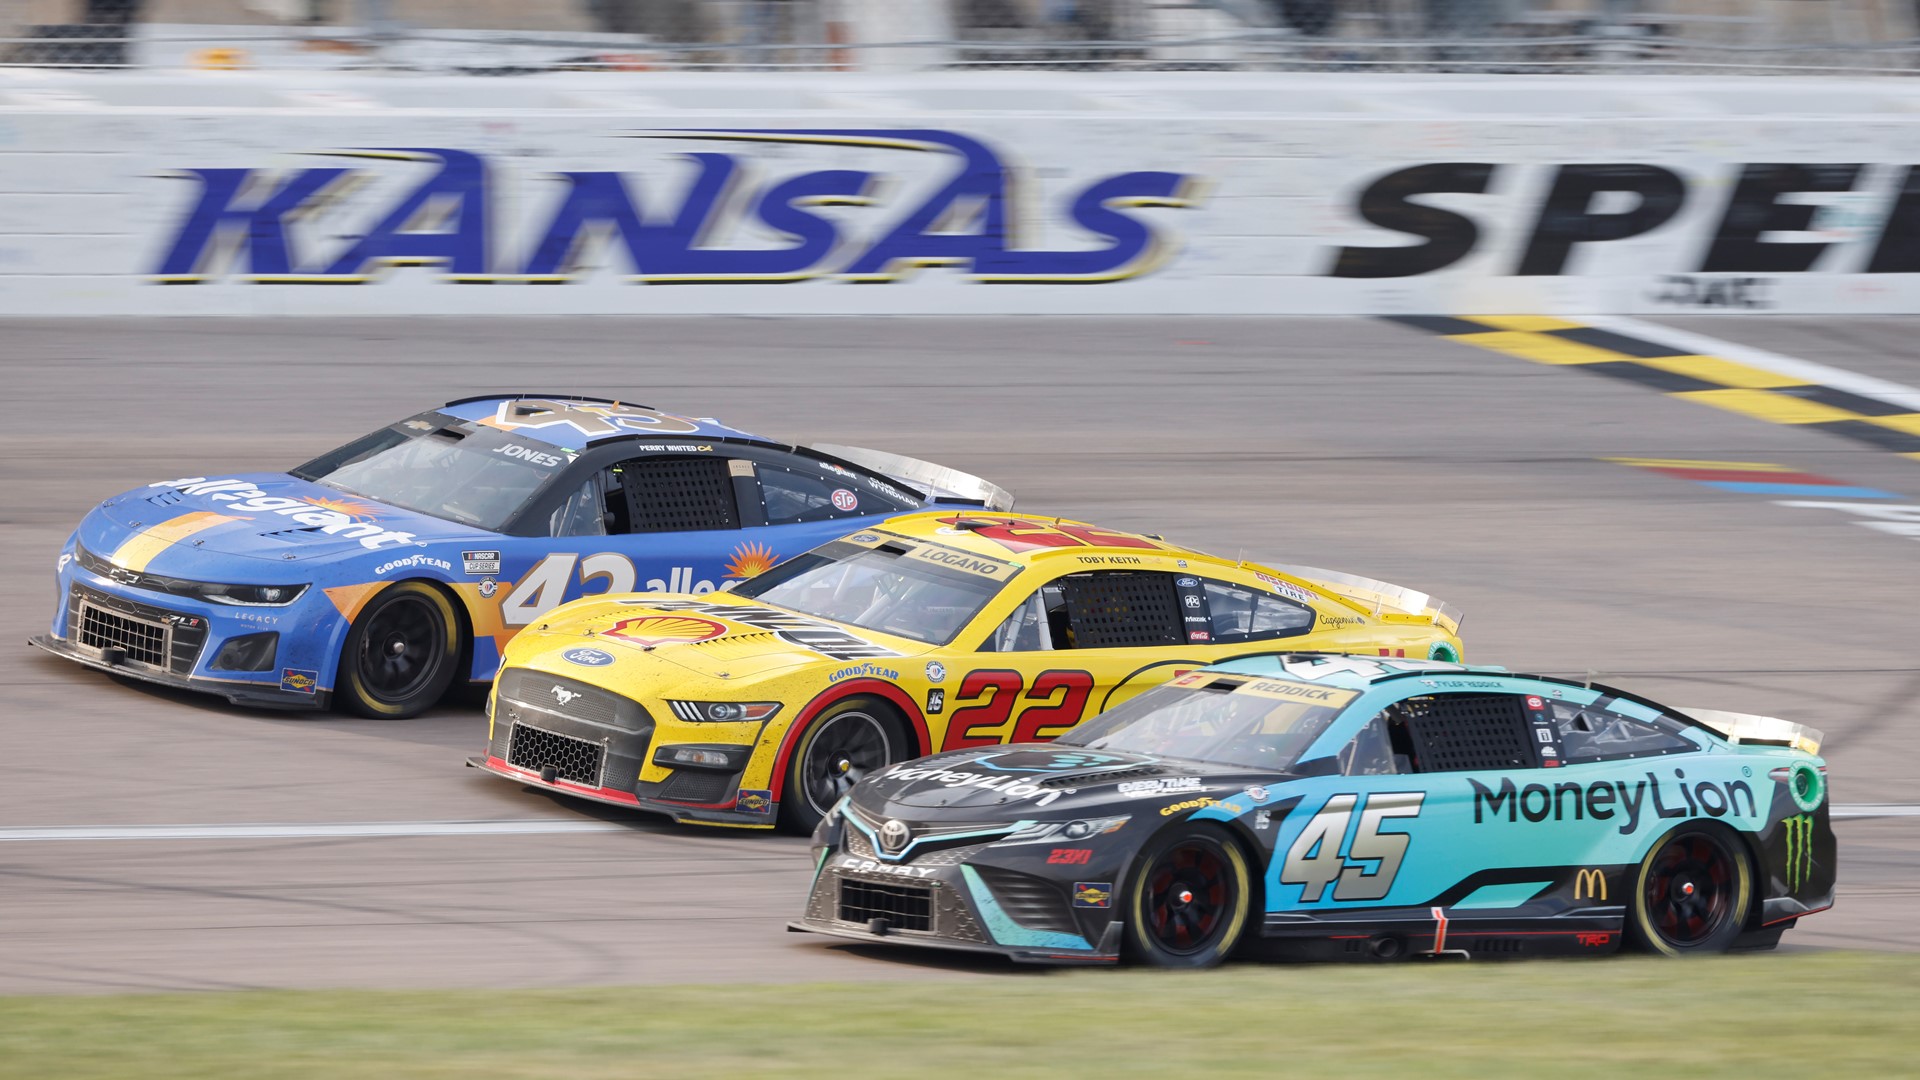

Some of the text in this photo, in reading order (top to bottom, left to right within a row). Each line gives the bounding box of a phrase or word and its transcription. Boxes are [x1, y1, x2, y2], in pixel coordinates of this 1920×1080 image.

[150, 129, 1210, 285] KANSAS
[493, 443, 562, 467] JONES
[819, 462, 857, 480] allegiant
[869, 476, 896, 492] CLUB
[834, 491, 854, 508] STP
[867, 479, 919, 508] WYNDHAM
[374, 554, 451, 575] GOODYEAR
[474, 552, 495, 560] NASCAR
[920, 548, 999, 575] LOGANO
[1077, 556, 1141, 565] TOBY KEITH
[1179, 578, 1197, 587] Ford
[1255, 571, 1320, 600] DISCOUNT
[1186, 596, 1200, 607] PPG
[1276, 586, 1306, 601] TIRE
[234, 611, 279, 625] LEGACY
[569, 649, 607, 664] Ford
[284, 676, 316, 686] SUNOCO
[828, 663, 900, 684] GOODYEAR
[1254, 680, 1337, 701] REDDICK
[942, 669, 1095, 751] 22
[882, 763, 1062, 807] MoneyLion
[739, 798, 770, 806] SUNOCO
[1466, 767, 1757, 835] MoneyLion
[1280, 791, 1426, 902] 45
[1576, 933, 1610, 947] TRD
